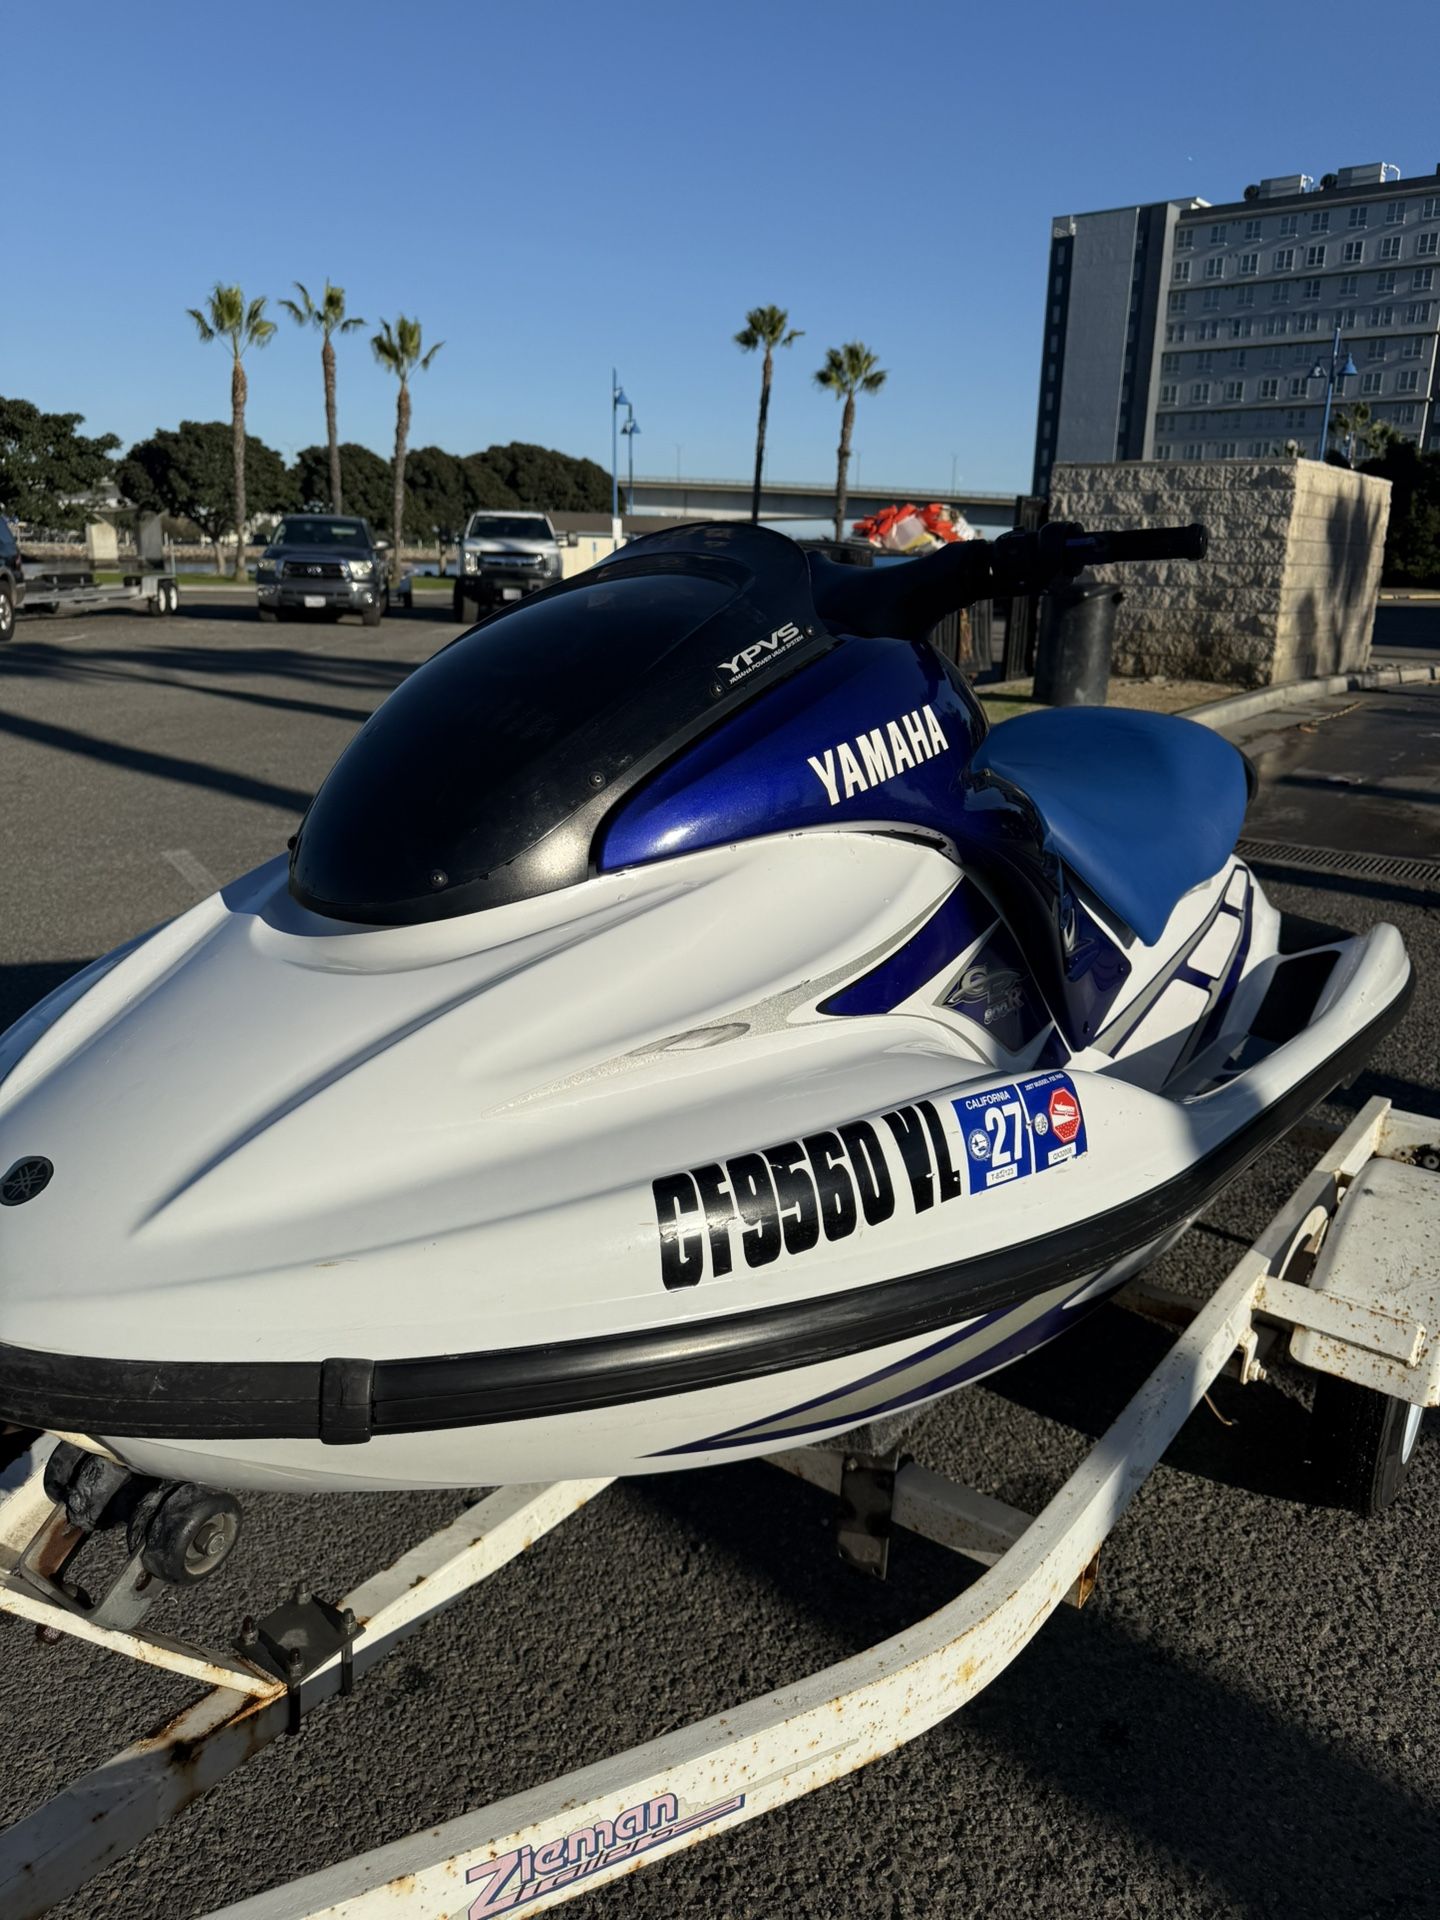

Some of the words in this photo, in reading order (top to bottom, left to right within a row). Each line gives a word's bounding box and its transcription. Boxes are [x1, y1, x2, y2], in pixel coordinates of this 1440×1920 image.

[717, 622, 800, 674] YPVS
[729, 665, 753, 685] YAMAHA
[751, 655, 773, 671] POWER
[771, 645, 787, 658] VALVE
[785, 634, 804, 649] SYSTEM
[807, 704, 949, 806] YAMAHA
[965, 1090, 1012, 1110] CALIFORNIA
[984, 1101, 1023, 1168] 27
[466, 1792, 678, 1920] Zieman
